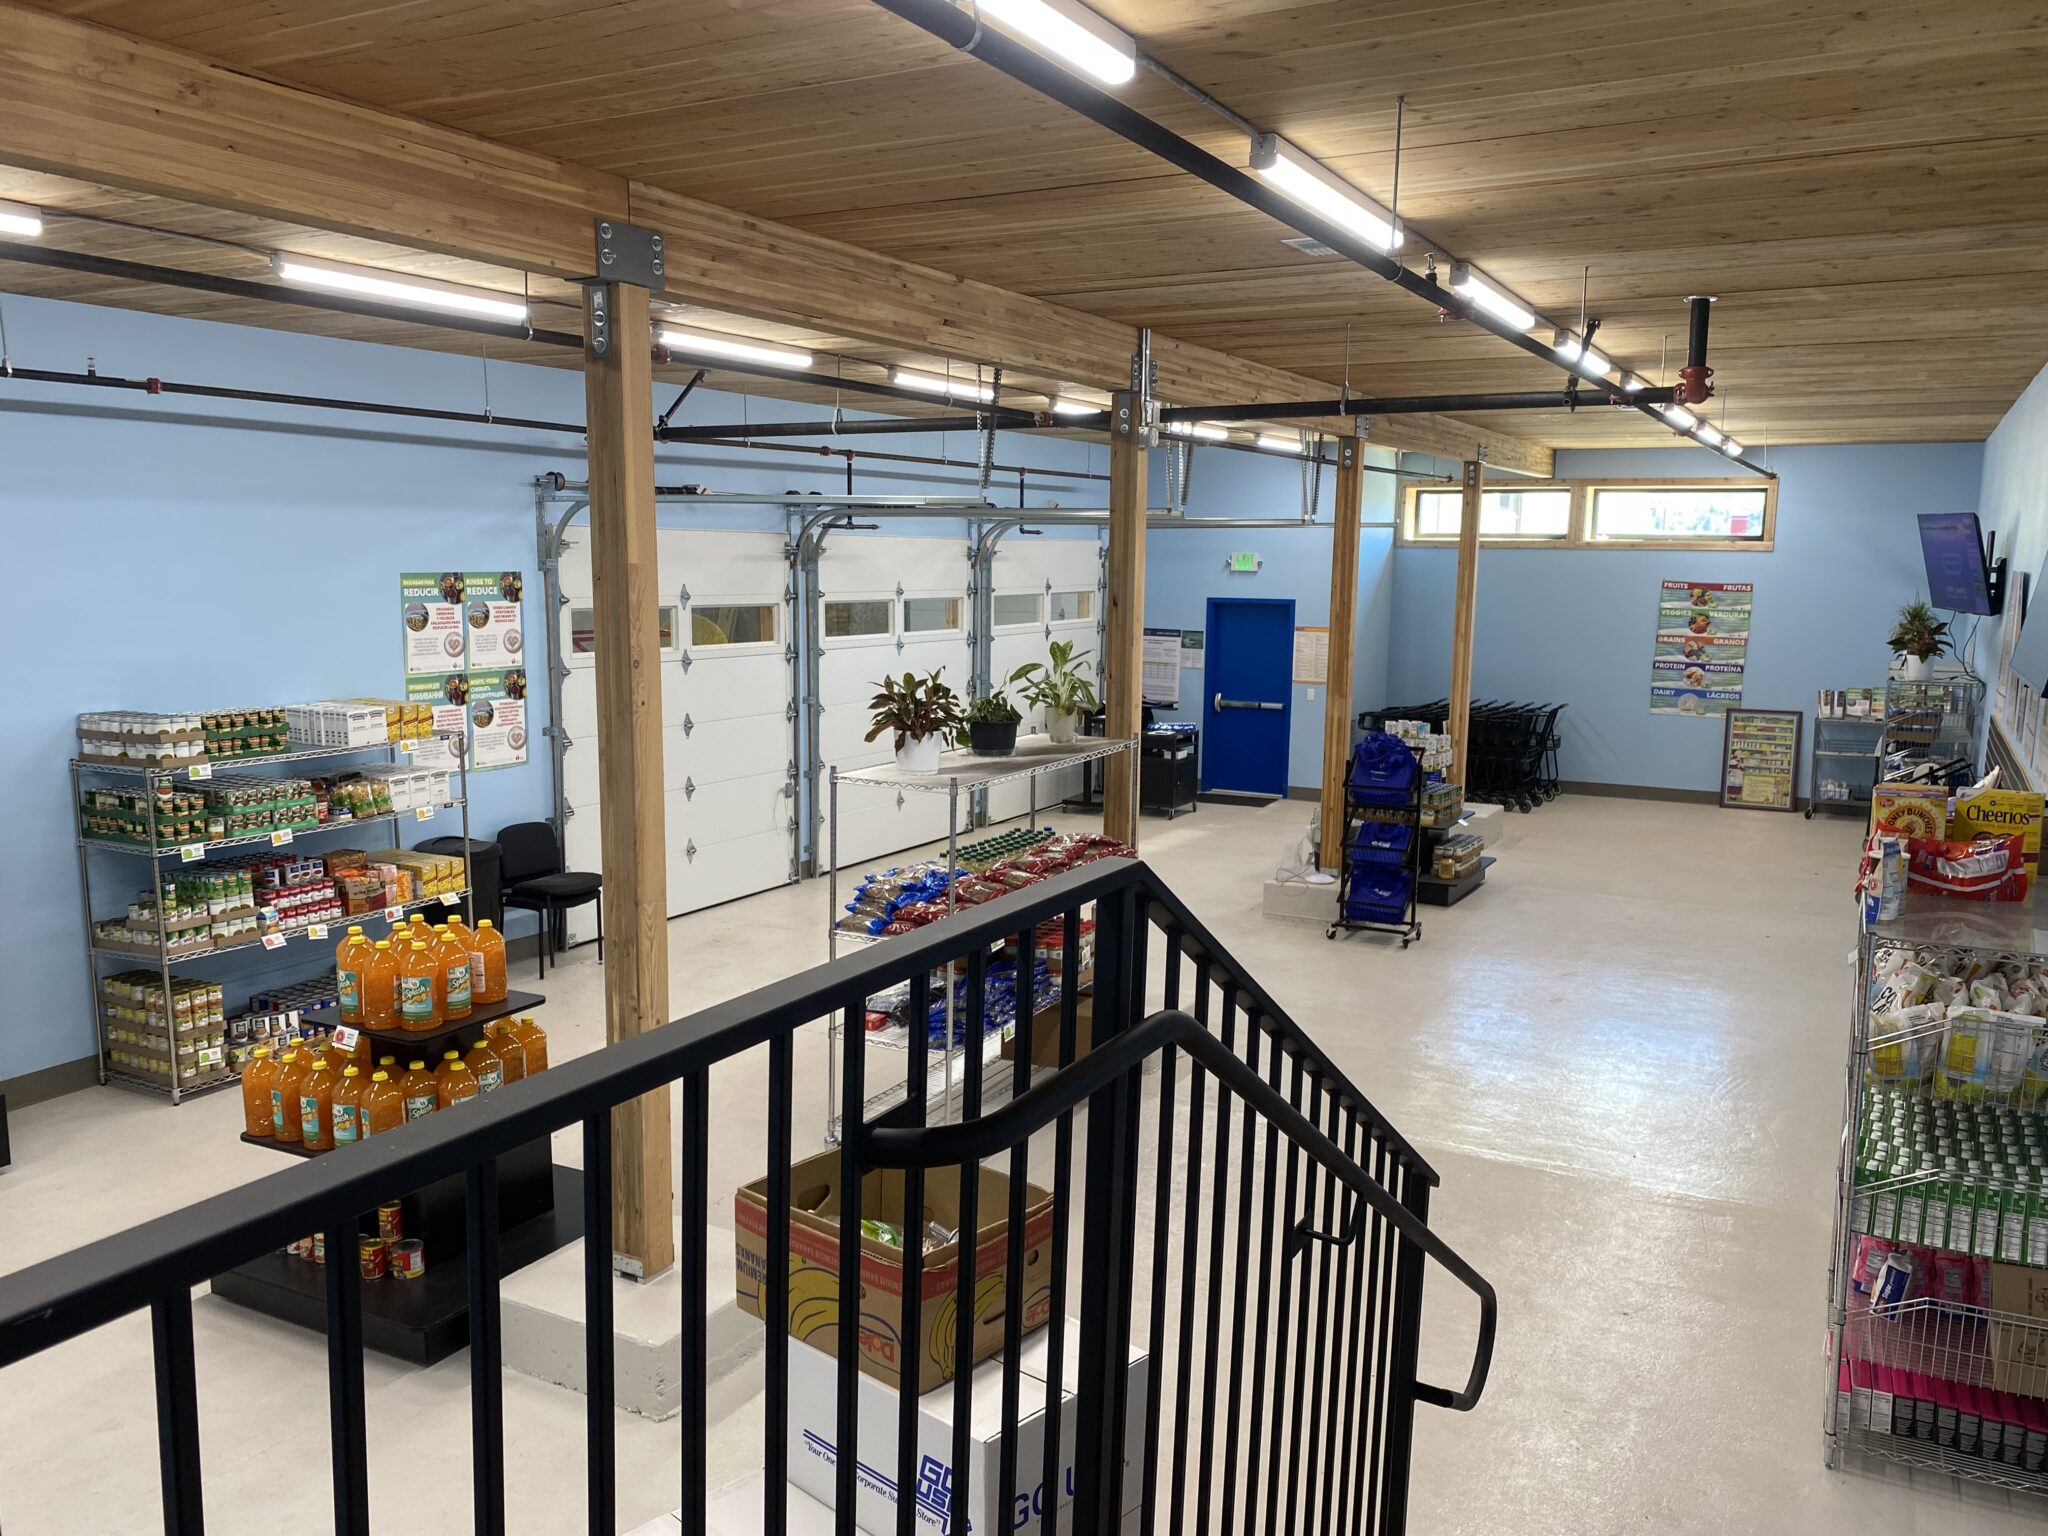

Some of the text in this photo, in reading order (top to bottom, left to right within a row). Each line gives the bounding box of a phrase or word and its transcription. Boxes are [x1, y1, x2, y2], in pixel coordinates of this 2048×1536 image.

[1663, 582, 1689, 590] FRUITS
[1723, 584, 1752, 592] FRUTAS
[404, 588, 439, 597] REDUCIR
[467, 587, 498, 596] REDUCE
[1708, 610, 1749, 618] VERDURAS
[1657, 636, 1686, 644] GRAINS
[1713, 638, 1745, 646] GRANOS
[1654, 662, 1686, 670] PROTEIN
[1705, 664, 1742, 673] PROTEÍNA
[1653, 688, 1676, 696] DAIRY
[1966, 804, 2030, 826] Cheerios
[1906, 807, 1933, 834] BUNCHES
[404, 985, 427, 999] Splash
[411, 1104, 433, 1119] Splash
[736, 1243, 767, 1271] ANANAS
[736, 1259, 767, 1284] REMIUM
[859, 1331, 895, 1362] Dole
[857, 1474, 888, 1497] orporate
